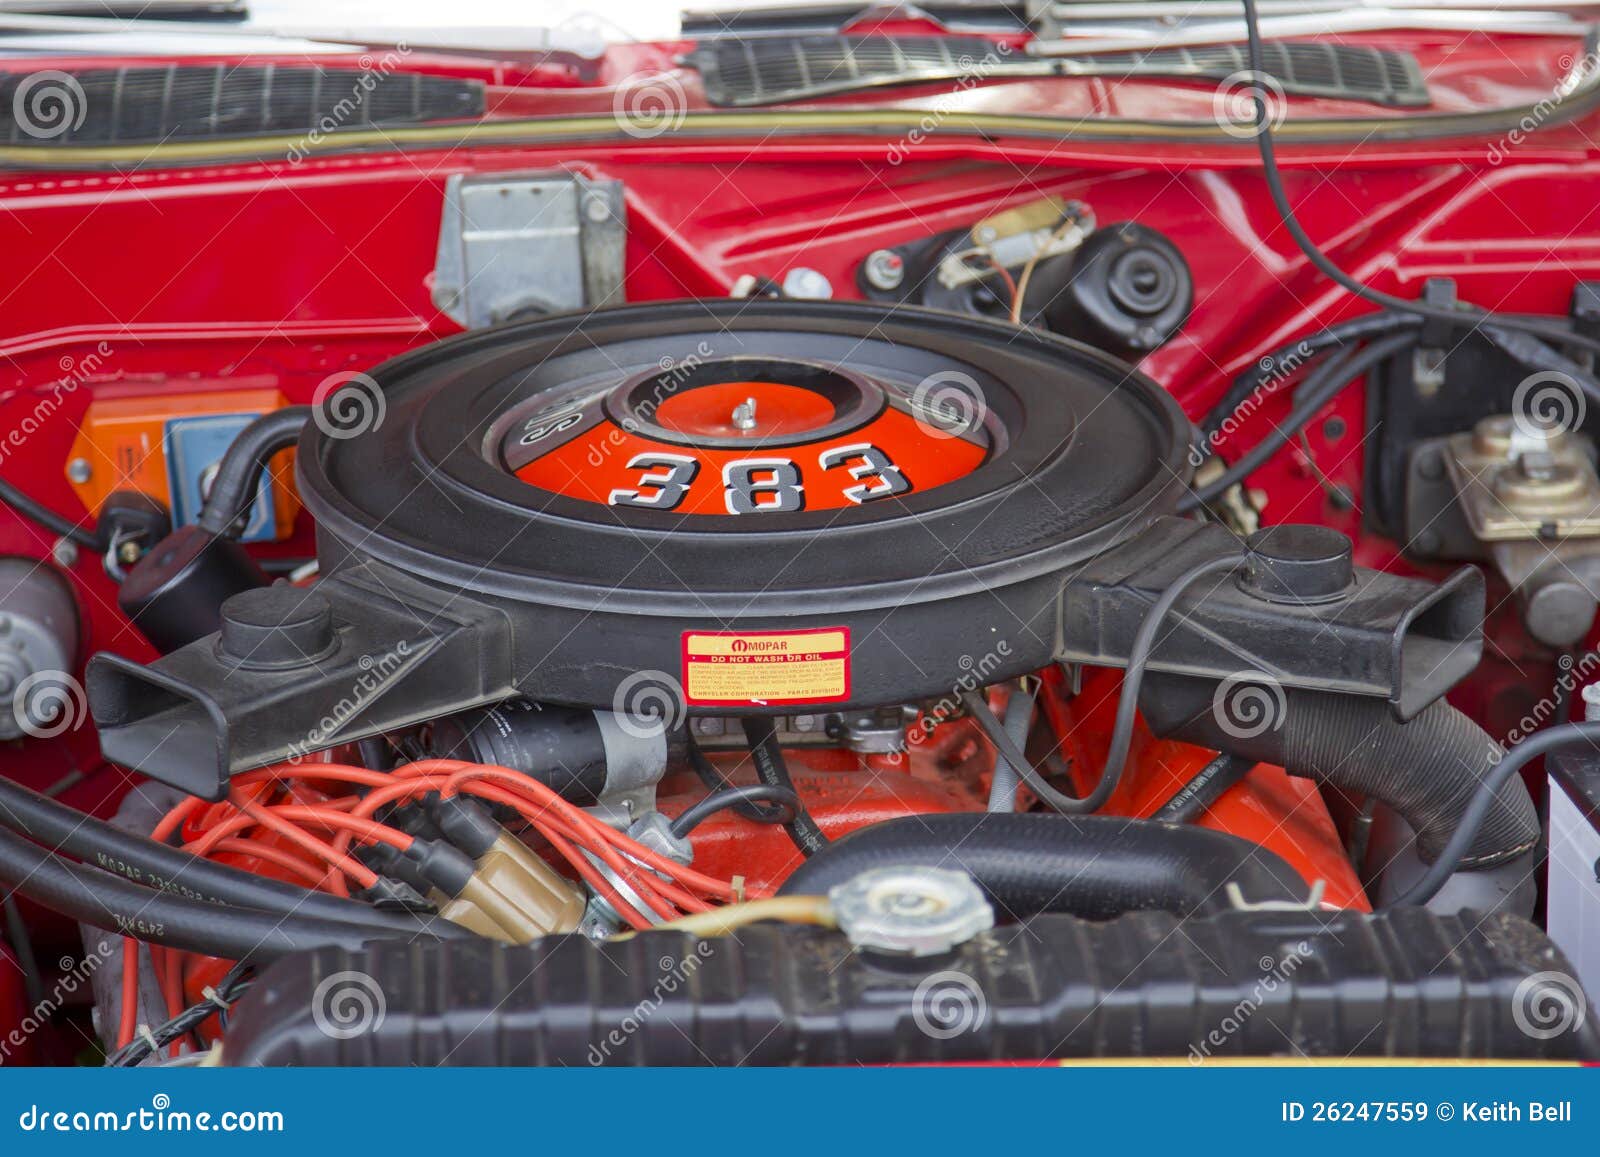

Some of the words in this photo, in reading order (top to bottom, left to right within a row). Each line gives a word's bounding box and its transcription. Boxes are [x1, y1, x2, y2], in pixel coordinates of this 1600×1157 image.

[608, 442, 913, 515] 383
[748, 640, 788, 651] MOPAR
[754, 655, 784, 663] WASH
[786, 654, 802, 662] OR
[805, 653, 822, 661] OIL
